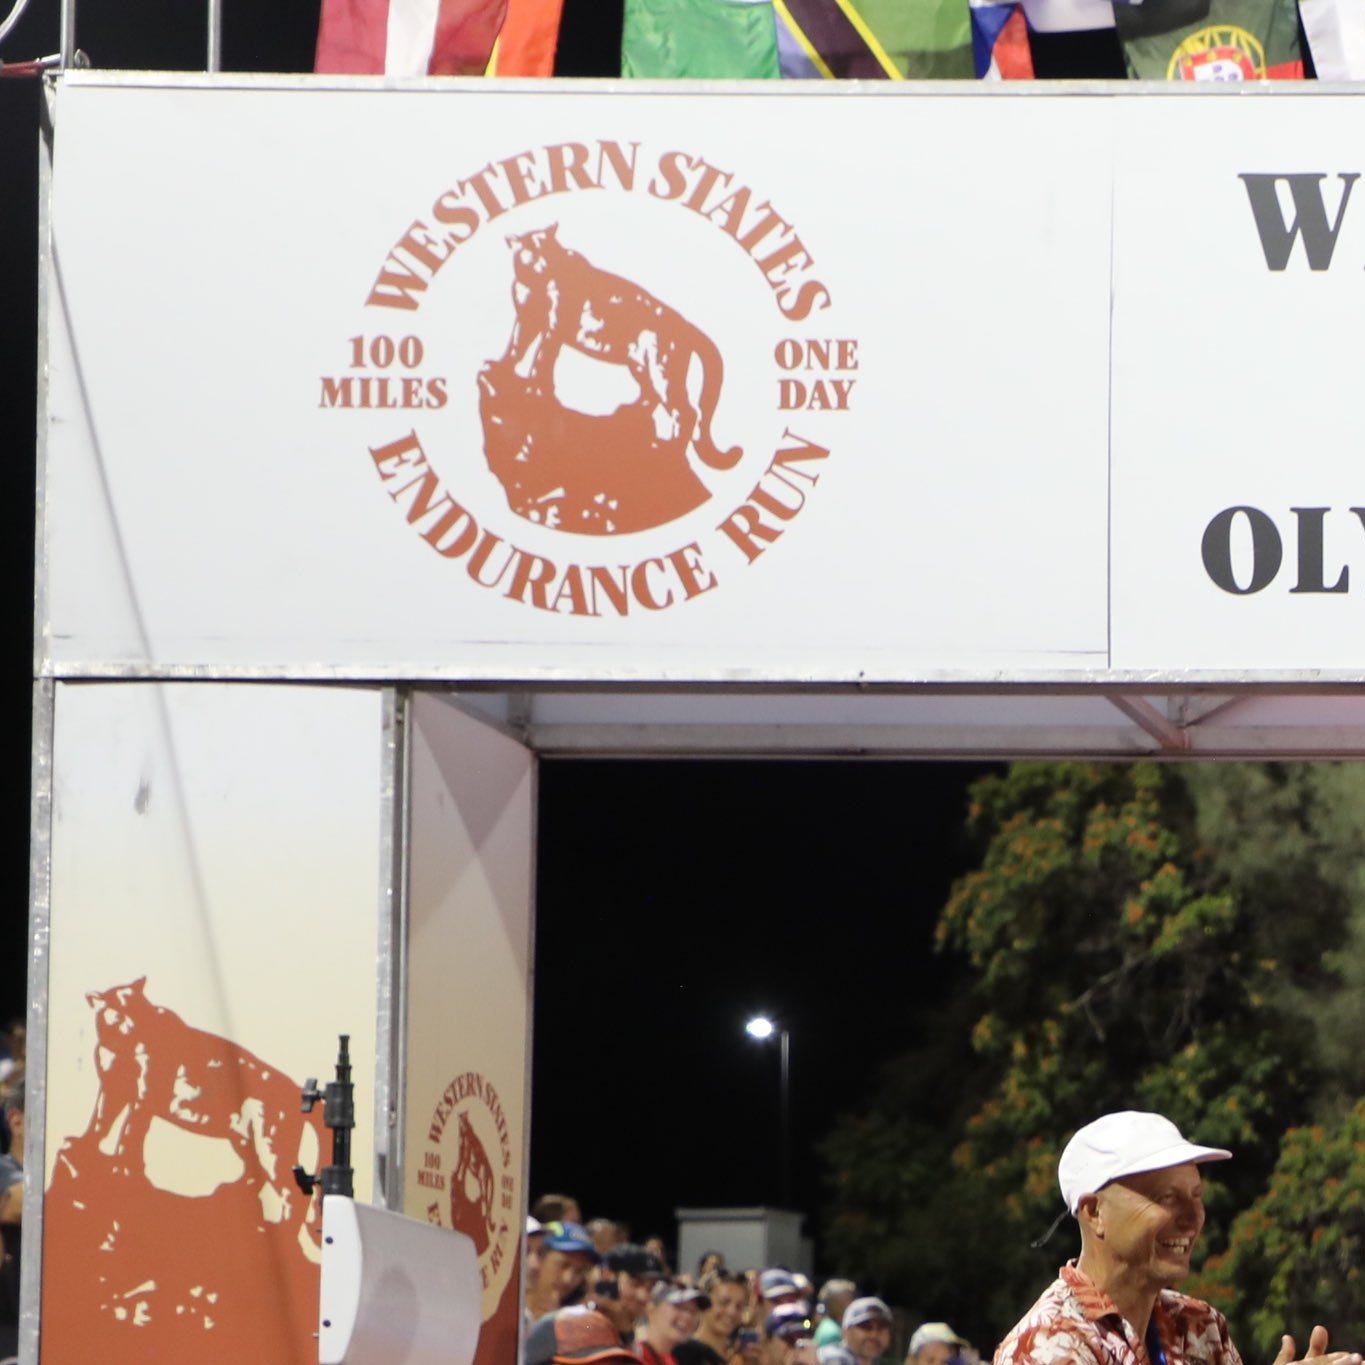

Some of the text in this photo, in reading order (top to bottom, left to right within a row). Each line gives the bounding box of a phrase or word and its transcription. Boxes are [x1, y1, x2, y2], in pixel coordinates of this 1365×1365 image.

[364, 140, 832, 322] WESTERN STATES
[346, 335, 424, 369] 100
[773, 338, 858, 371] ONE
[318, 378, 449, 409] MILES
[776, 380, 856, 411] DAY
[367, 427, 832, 618] ENDURANCE RUN
